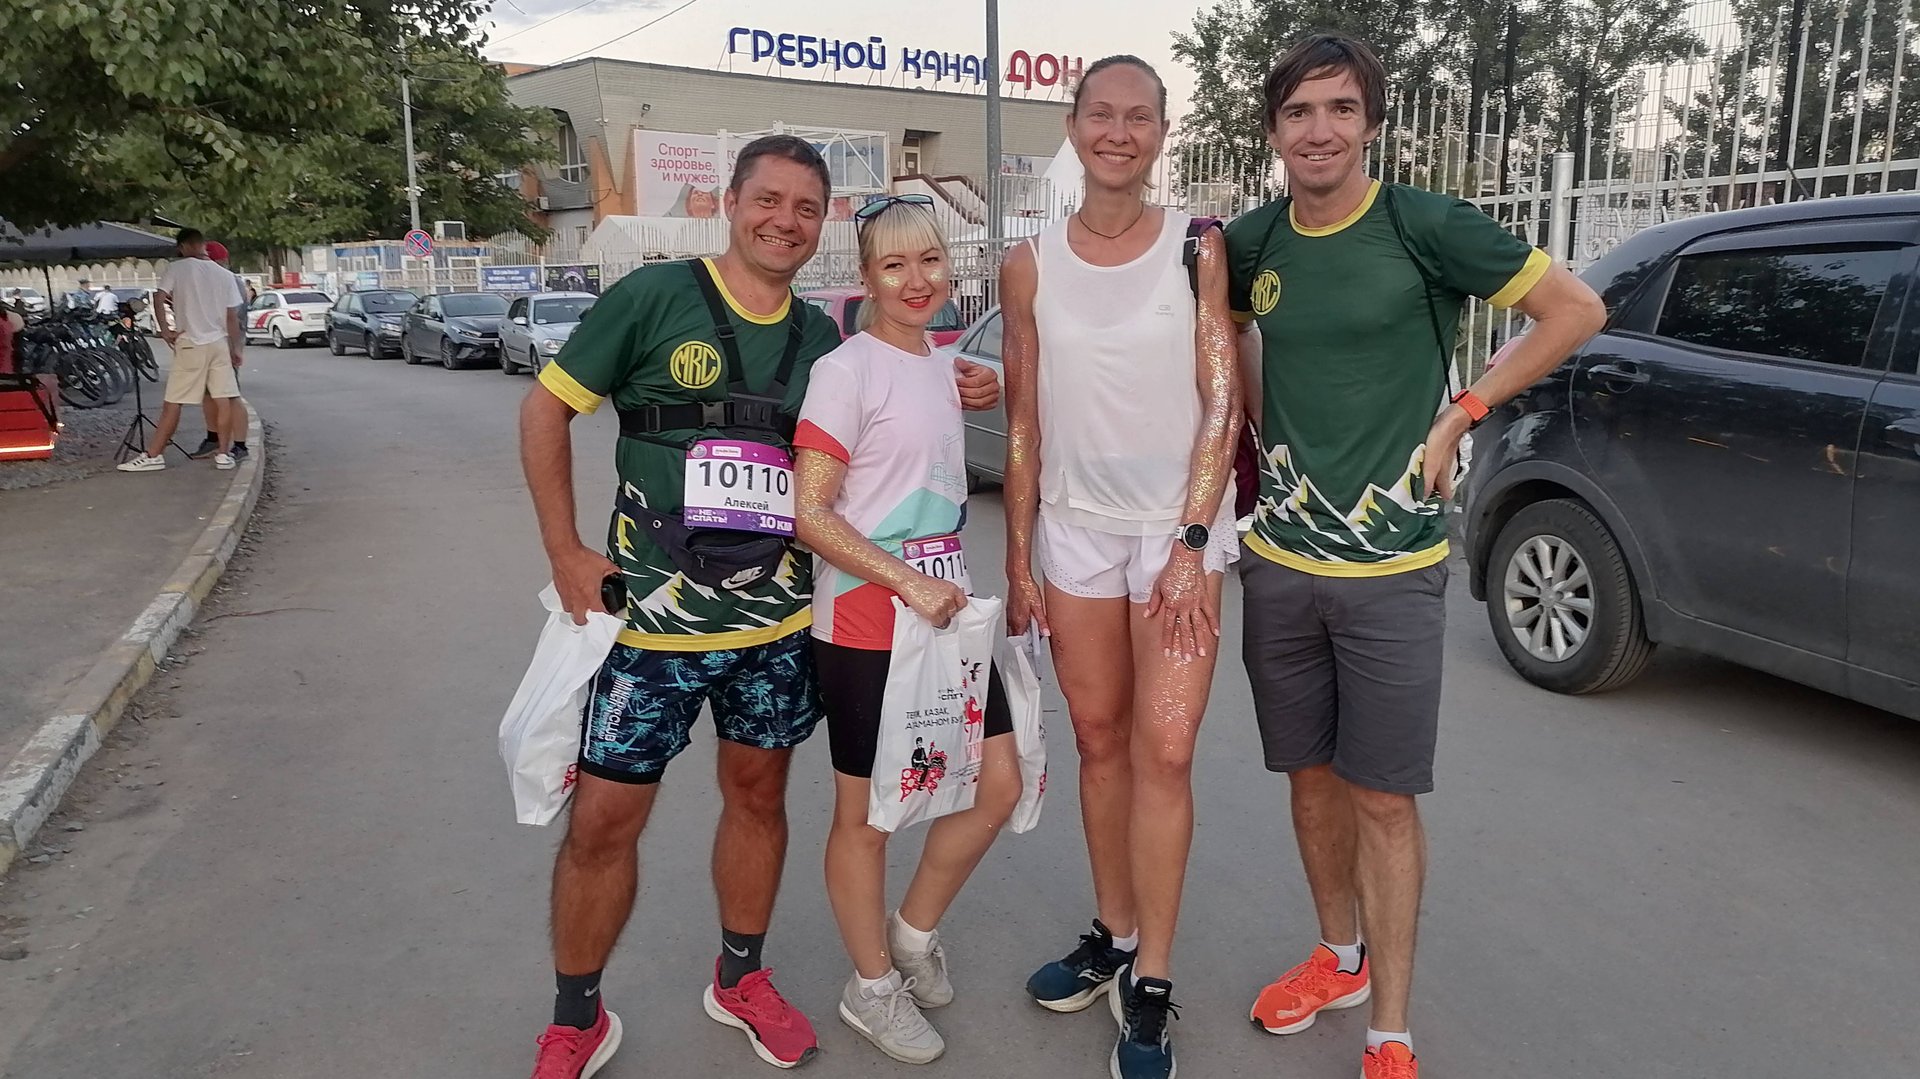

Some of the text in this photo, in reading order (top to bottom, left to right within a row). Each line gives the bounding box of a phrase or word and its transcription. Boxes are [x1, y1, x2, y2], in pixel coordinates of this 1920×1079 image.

[728, 26, 886, 71] ГРЕБНОЙ
[1005, 49, 1084, 91] ДОН
[658, 143, 699, 159] Спорт
[650, 158, 716, 173] здоровье,
[662, 172, 671, 182] и
[1252, 272, 1278, 312] MRC
[674, 344, 717, 385] MRC
[698, 460, 789, 496] 10110
[724, 496, 769, 511] Алексей
[760, 515, 776, 529] 10
[916, 552, 968, 580] 1011
